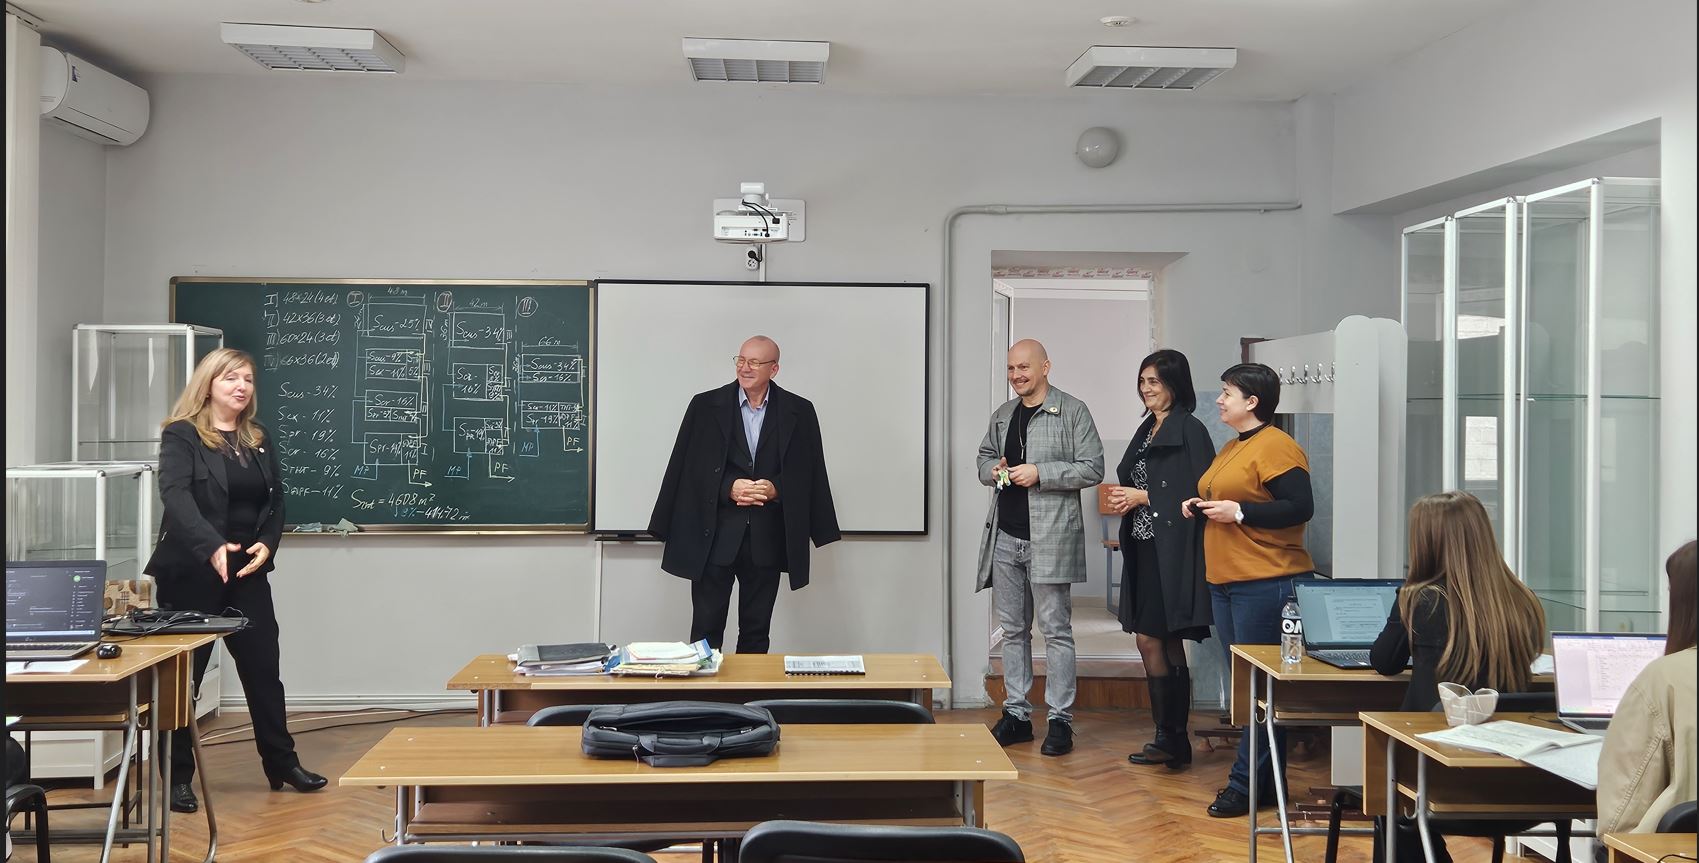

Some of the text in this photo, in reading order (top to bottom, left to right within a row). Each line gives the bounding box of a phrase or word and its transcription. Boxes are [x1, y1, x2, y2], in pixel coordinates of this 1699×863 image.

[566, 436, 580, 446] PF
[494, 461, 509, 474] PF
[413, 468, 428, 480] PF
